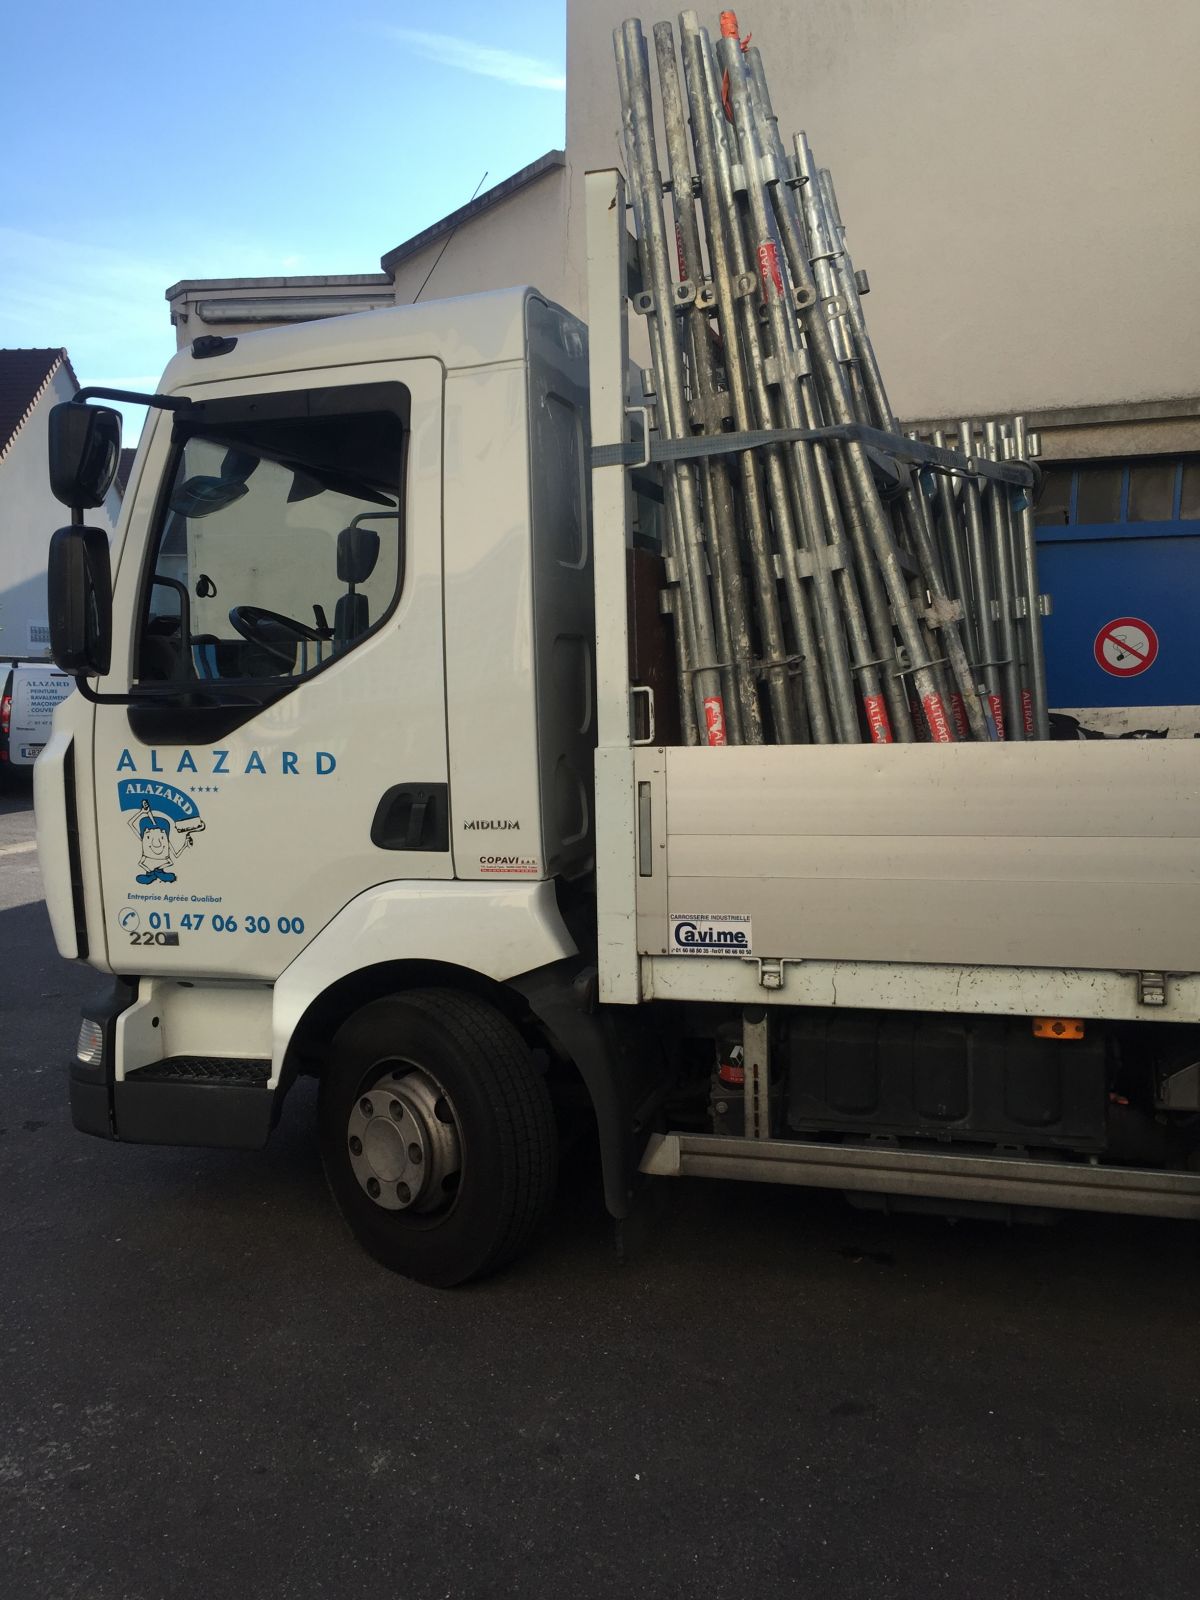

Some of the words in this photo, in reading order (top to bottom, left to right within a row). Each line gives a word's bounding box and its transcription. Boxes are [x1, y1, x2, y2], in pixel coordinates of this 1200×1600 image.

[930, 695, 949, 742] ALTRAD
[1023, 692, 1034, 732] ALTRAD
[116, 748, 337, 774] ALAZARD
[125, 783, 193, 815] ALAZARD
[464, 820, 520, 830] MIDLUM
[127, 892, 162, 902] Entreprise
[149, 911, 171, 930] 01
[180, 914, 205, 931] 47
[211, 914, 238, 933] 06
[244, 915, 271, 934] 30
[277, 916, 305, 935] 00
[129, 931, 168, 946] 220
